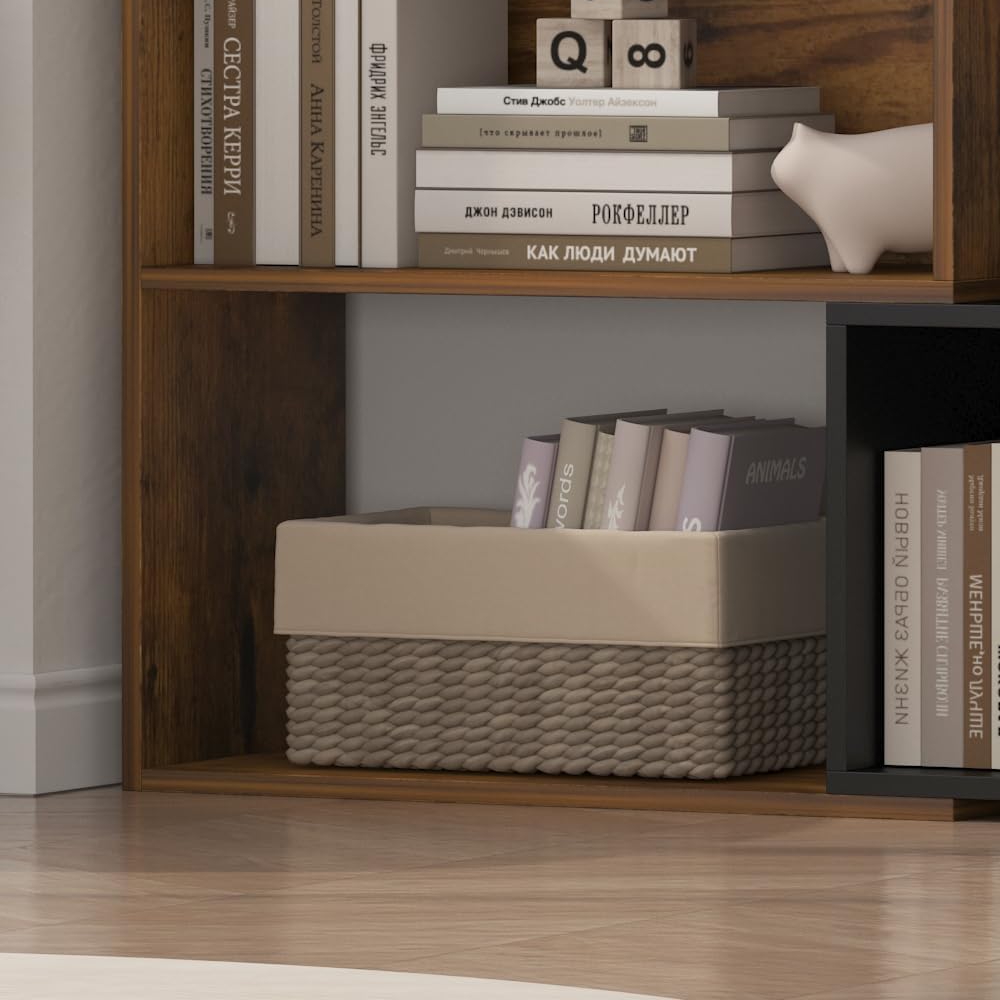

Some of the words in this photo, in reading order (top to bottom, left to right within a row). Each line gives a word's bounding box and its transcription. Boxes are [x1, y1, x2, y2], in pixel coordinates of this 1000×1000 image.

[550, 30, 588, 73] Q
[627, 43, 666, 69] 8
[223, 36, 242, 120] СЕСТРА
[368, 43, 388, 100] ФРИДРИХ
[503, 96, 529, 106] Стив
[531, 96, 566, 107] Джобс
[568, 97, 605, 109] Уолтер
[608, 97, 657, 108] Айзексон
[200, 68, 213, 194] СТИХОТВОРЕНИЯ
[369, 106, 387, 156] ЭНГЕЛЬС
[504, 129, 551, 139] скрывает
[223, 126, 242, 196] КЕРРИ
[465, 206, 498, 220] ДЖОН
[501, 206, 553, 220] ДЭВИСОН
[591, 203, 690, 226] РОКФЕЛЛЕР
[526, 245, 559, 261] КАК
[563, 245, 616, 263] ЛЮДИ
[622, 246, 698, 264] ДУМАЮТ
[745, 457, 807, 485] ANIMALS
